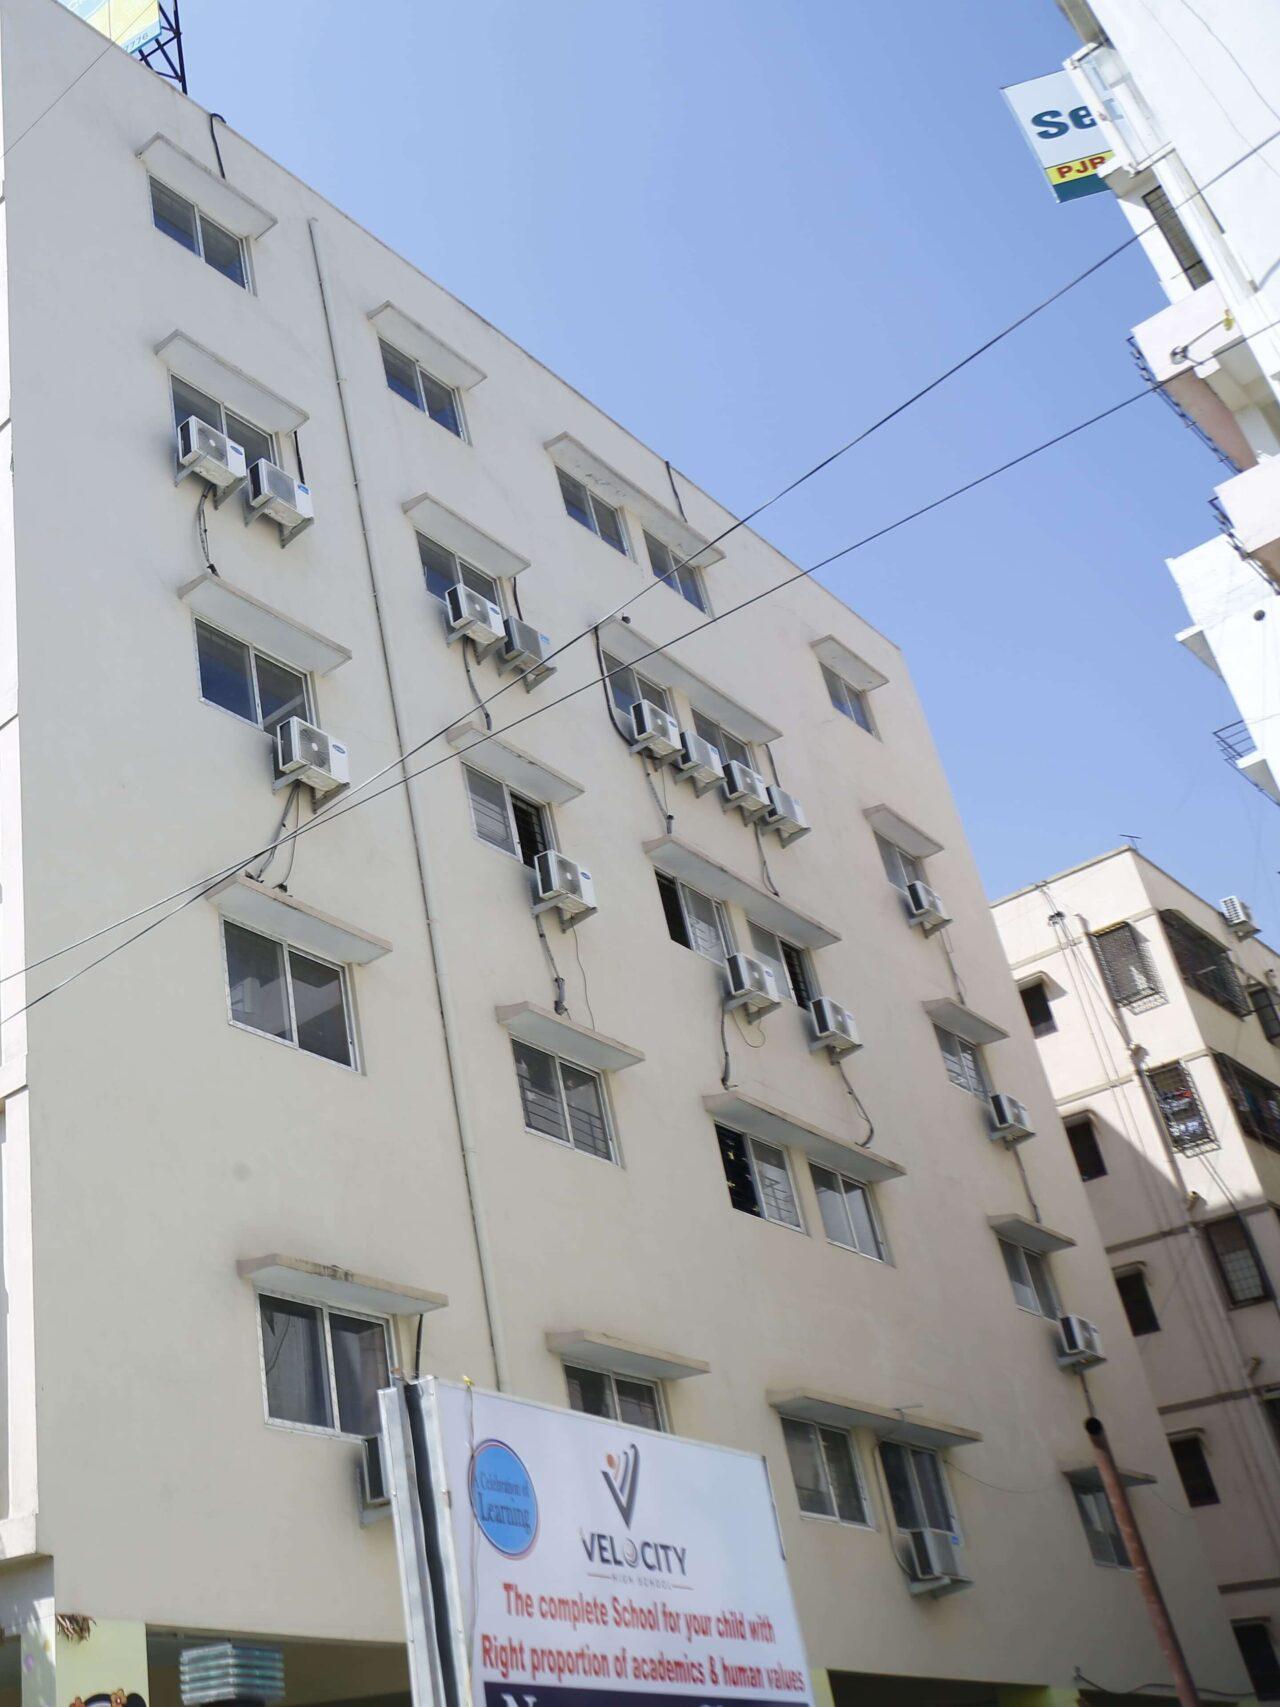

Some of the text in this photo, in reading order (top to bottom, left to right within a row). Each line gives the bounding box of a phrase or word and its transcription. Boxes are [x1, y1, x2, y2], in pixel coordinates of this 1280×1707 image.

[1031, 98, 1124, 139] Se
[478, 1491, 532, 1536] Learning
[581, 1531, 686, 1576] VELOCITY
[503, 1583, 776, 1644] The complete School for your child with
[482, 1634, 806, 1692] Right proportion of academics & human values
